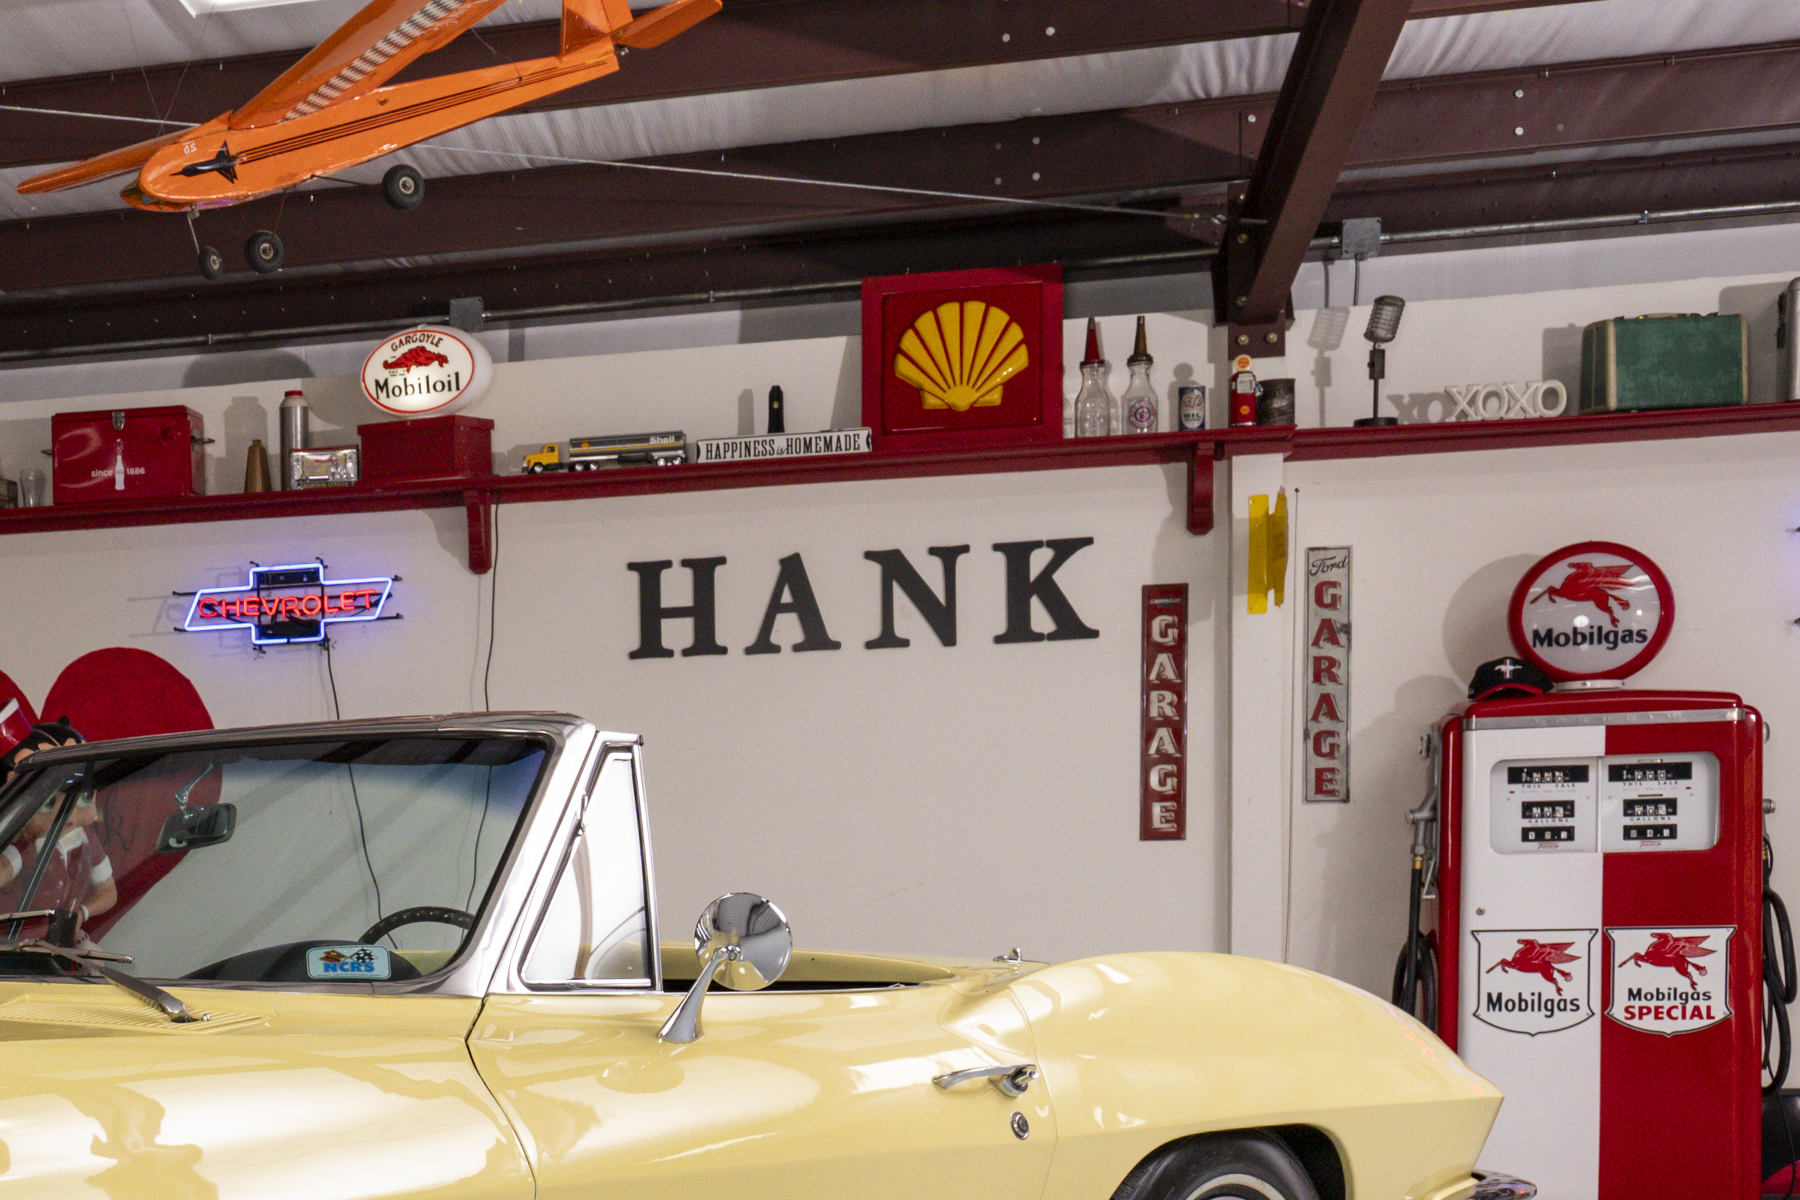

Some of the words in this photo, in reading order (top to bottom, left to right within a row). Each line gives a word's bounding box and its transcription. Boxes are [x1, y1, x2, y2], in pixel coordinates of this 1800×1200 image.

[391, 333, 443, 352] GARGOYLE
[374, 371, 461, 400] Mobiloil
[1444, 379, 1567, 423] XOXO
[650, 435, 675, 445] Shell
[705, 439, 775, 461] HAPPINESS
[786, 433, 861, 456] HOMEMADE
[91, 468, 113, 478] since
[126, 467, 146, 475] 1886
[1309, 554, 1349, 577] Ford
[198, 588, 377, 619] CHEVROLET
[626, 536, 1101, 661] HANK
[1532, 625, 1648, 651] Mobilgas
[1310, 580, 1345, 798] GARAGE
[1148, 614, 1182, 832] GARAGE
[323, 961, 376, 973] NCRS
[1486, 991, 1581, 1019] Mobilgas
[1627, 987, 1712, 1005] Mobilgas
[1623, 1004, 1716, 1021] SPECIAL
